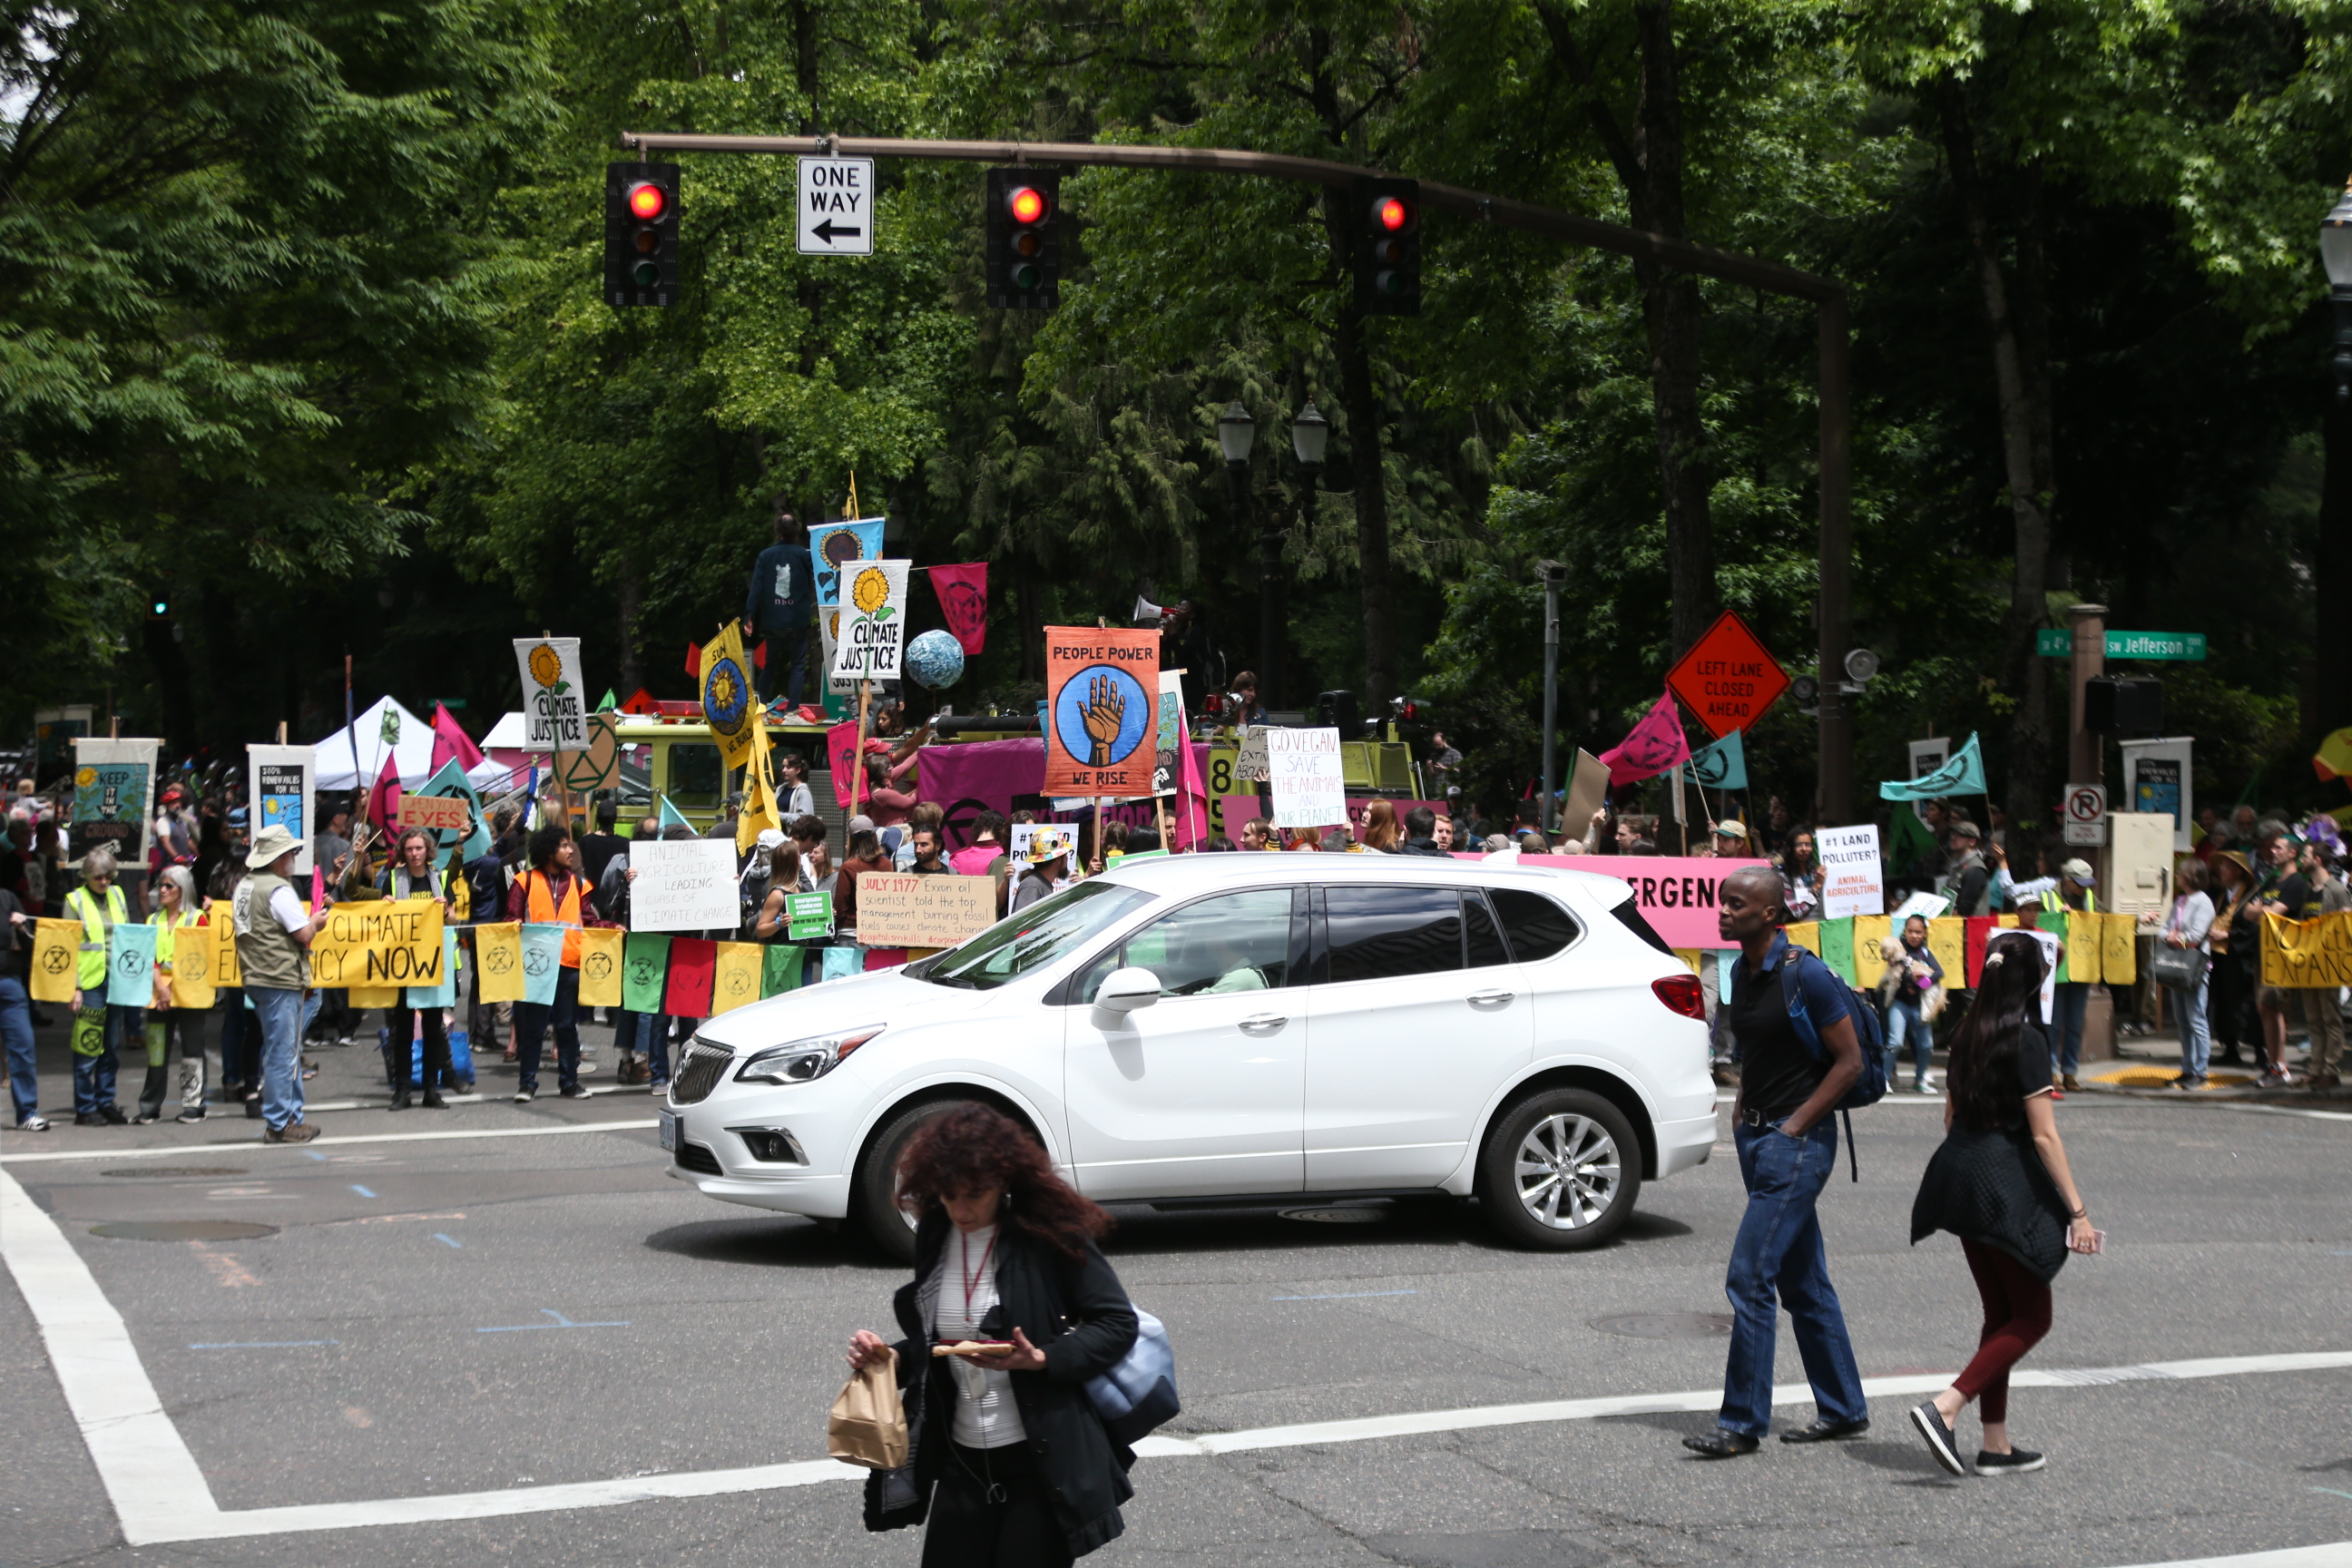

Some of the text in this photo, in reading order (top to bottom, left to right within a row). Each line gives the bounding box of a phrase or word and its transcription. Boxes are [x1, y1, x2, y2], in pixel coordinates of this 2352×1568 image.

[812, 166, 860, 188] ONE
[810, 191, 861, 213] WAY
[854, 622, 898, 644] CLIMATE
[1053, 646, 1153, 661] PEOPLE POWER
[2124, 636, 2183, 655] Jefferson
[840, 646, 896, 671] JUSTICE
[1697, 661, 1764, 678] LEFT LANE
[1704, 681, 1755, 698] CLOSED
[538, 696, 578, 717] CLIMATE
[1707, 701, 1750, 718] AHEAD
[531, 718, 581, 742] JUSTICE
[726, 727, 753, 755] WE BUILD
[1291, 730, 1337, 753] VEGAN
[1285, 755, 1320, 775] SAVE
[98, 771, 130, 786] KEEP
[1073, 771, 1128, 786] WE RISE
[1272, 776, 1344, 795] THE ANIMALS
[101, 805, 117, 815] THE
[403, 797, 465, 813] OPEN YOUR
[1298, 795, 1319, 808] AND
[404, 810, 462, 828] EYES
[1276, 810, 1297, 827] OUR
[1299, 806, 1343, 827] PLANET
[84, 823, 129, 838] GROUND
[1825, 833, 1871, 847] #1 LAND
[649, 843, 708, 862] ANIMAL
[1822, 849, 1877, 865] POLLUTER?
[664, 877, 712, 892] LEADING
[861, 878, 889, 892] JULY
[925, 879, 952, 893] Exxon
[958, 880, 971, 894] oil
[1838, 875, 1868, 887] ANIMAL
[1627, 877, 1727, 908] ERGEN
[1827, 884, 1880, 898] AGRICULTURE
[645, 895, 677, 906] CUASE
[865, 896, 976, 914] scientist told the top
[636, 906, 733, 926] CLIMATE CHANGE
[861, 908, 989, 925] management burning fossil
[332, 913, 423, 943] CLIMATE
[860, 920, 880, 931] fuels
[886, 922, 910, 931] causes
[916, 922, 949, 934] climate
[858, 933, 921, 944] #capitalismkills
[367, 946, 440, 982] NOW
